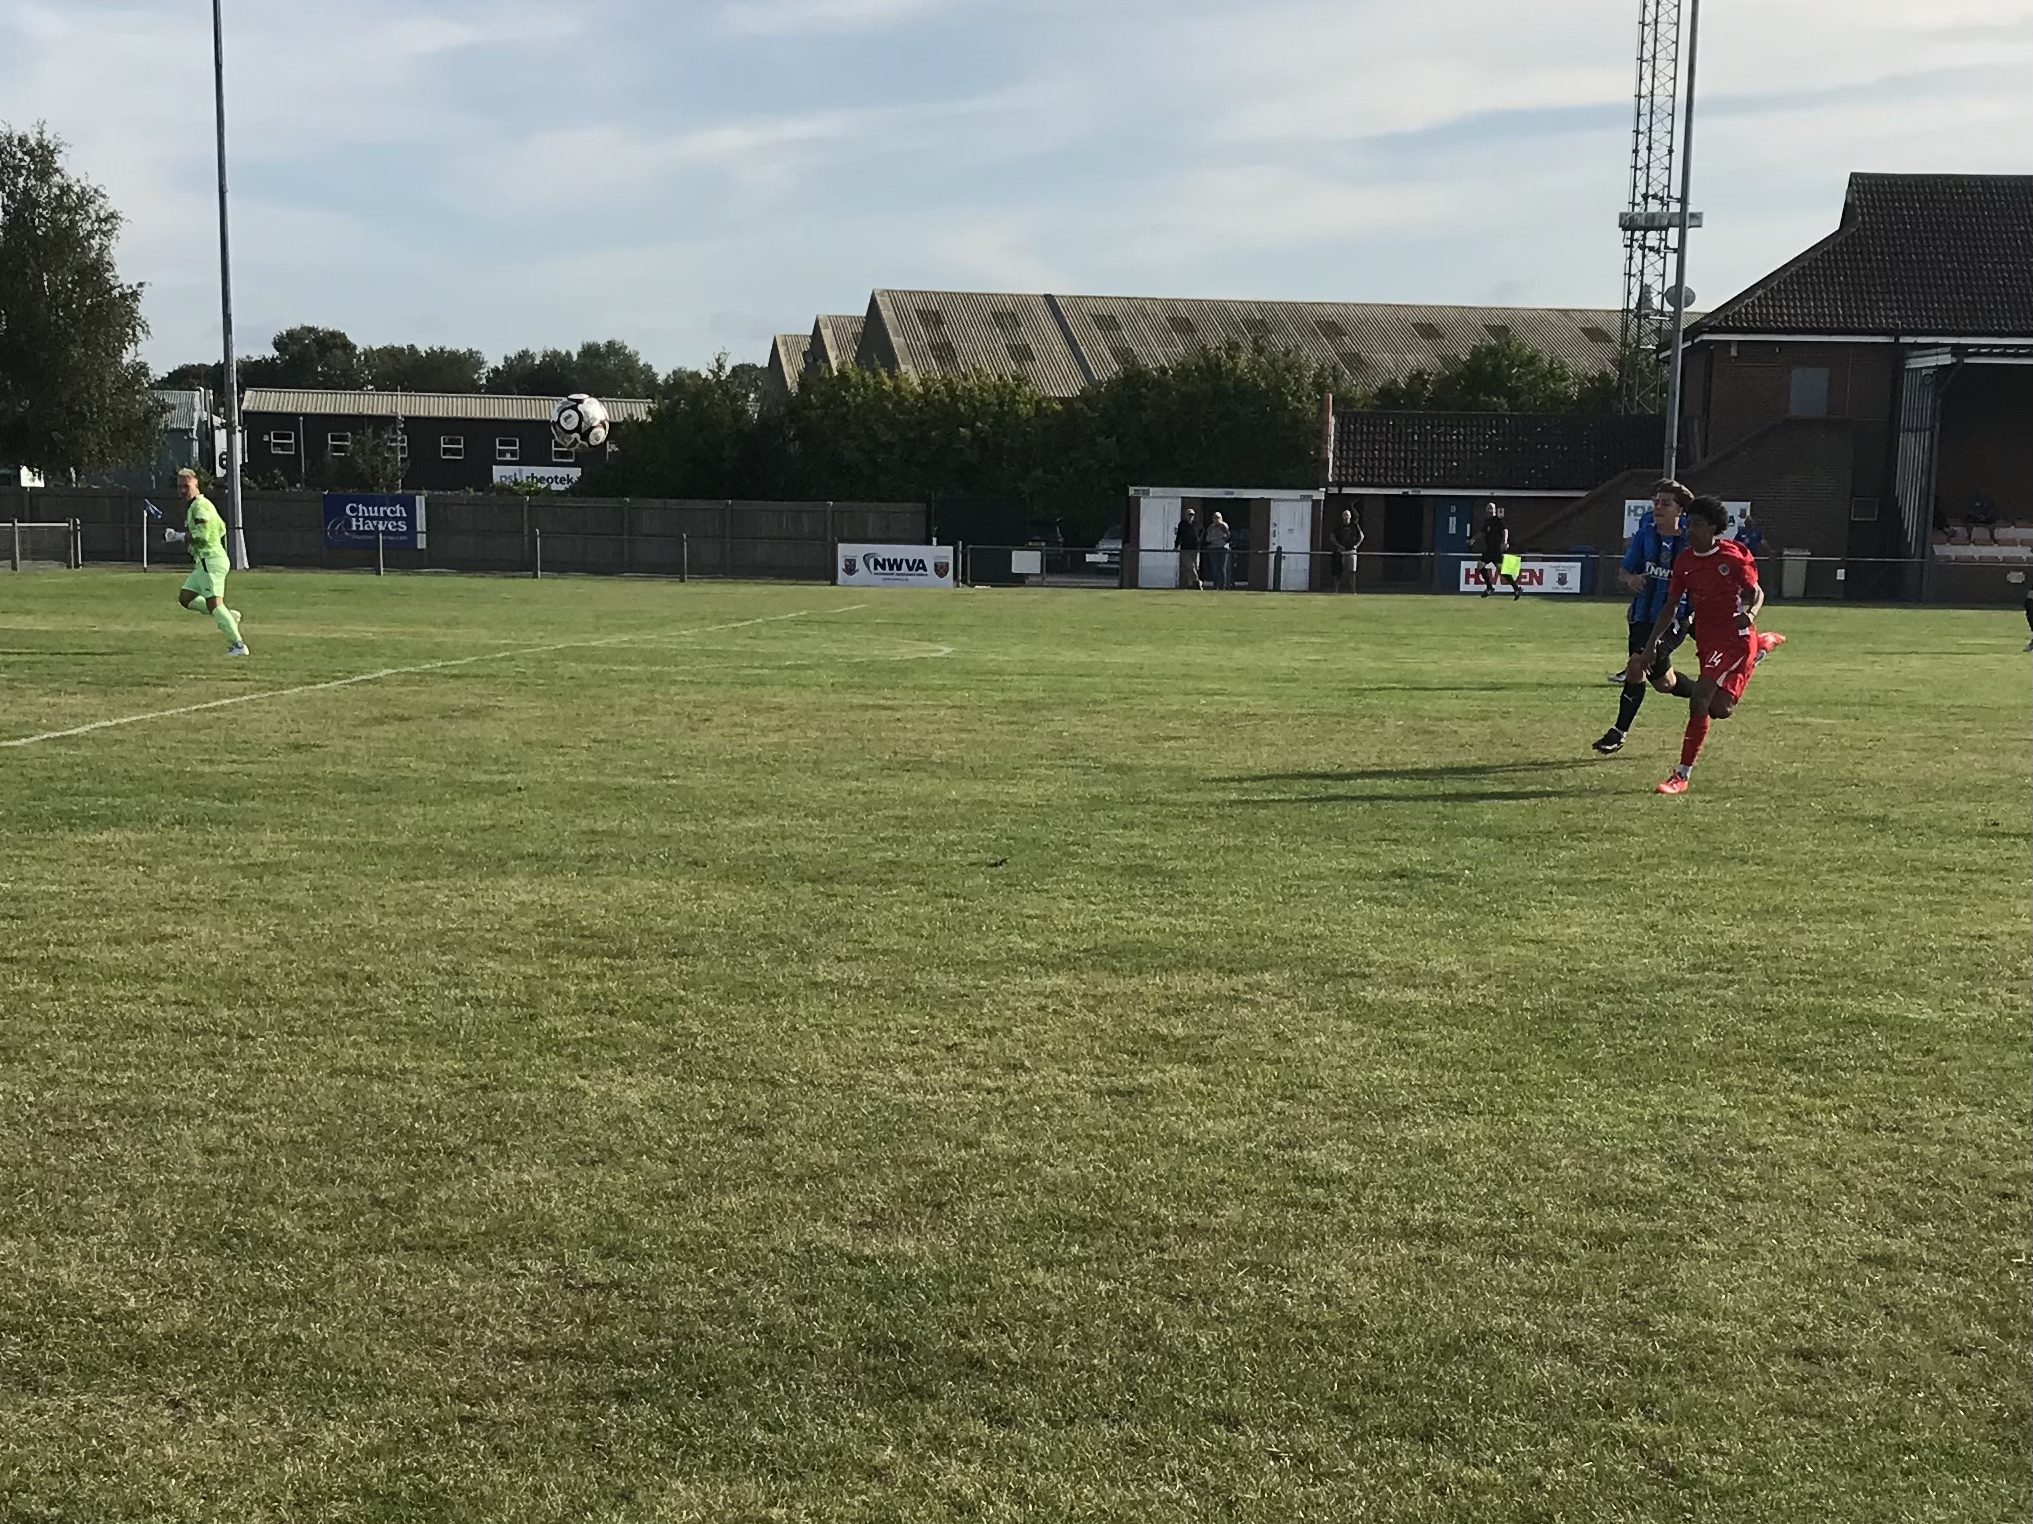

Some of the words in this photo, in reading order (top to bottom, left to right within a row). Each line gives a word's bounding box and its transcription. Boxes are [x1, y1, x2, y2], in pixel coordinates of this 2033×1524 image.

[345, 503, 407, 517] Church
[351, 517, 407, 532] Hawes
[873, 558, 928, 572] NWVA
[1464, 567, 1545, 586] HWEN
[1708, 650, 1723, 667] 14
